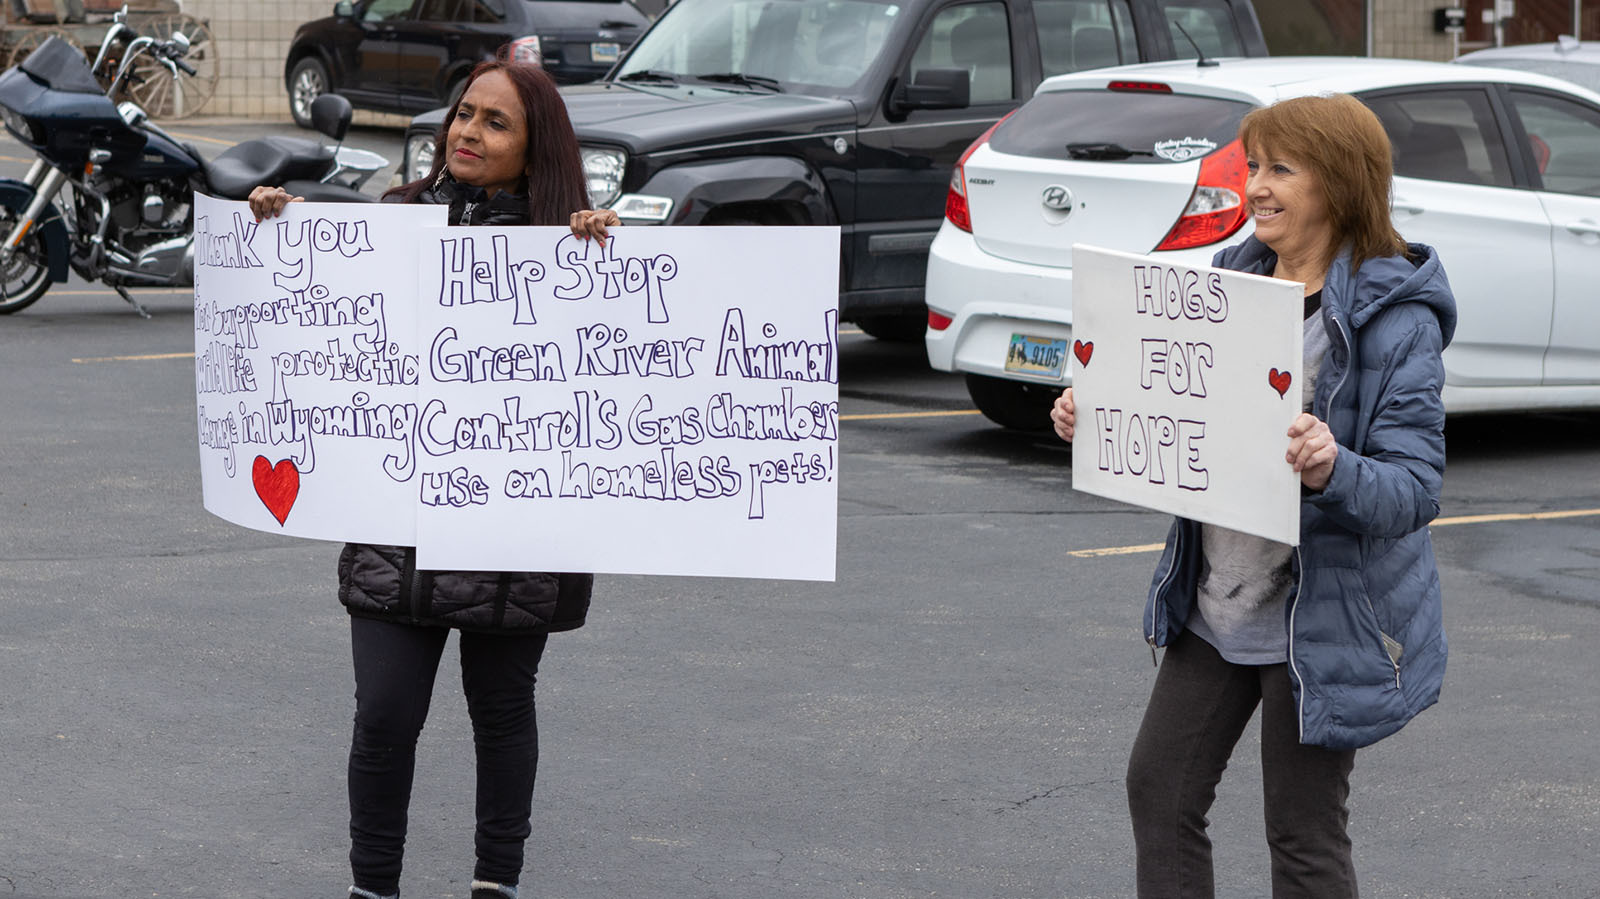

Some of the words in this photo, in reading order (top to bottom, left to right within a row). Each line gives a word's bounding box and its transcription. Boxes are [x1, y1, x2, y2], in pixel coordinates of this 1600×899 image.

[439, 234, 545, 325] Help
[553, 233, 677, 323] Stop
[1133, 265, 1229, 323] HOGS
[272, 338, 419, 404] protectio
[429, 326, 566, 383] Green
[574, 323, 704, 378] River
[715, 307, 838, 384] Animal
[265, 391, 419, 482] Wyoming
[418, 390, 622, 456] Control's
[628, 394, 705, 445] Gas
[1095, 407, 1209, 491] HOPE
[420, 466, 489, 507] use
[504, 468, 552, 498] on
[559, 447, 742, 501] homeless
[748, 445, 833, 519] pets!
